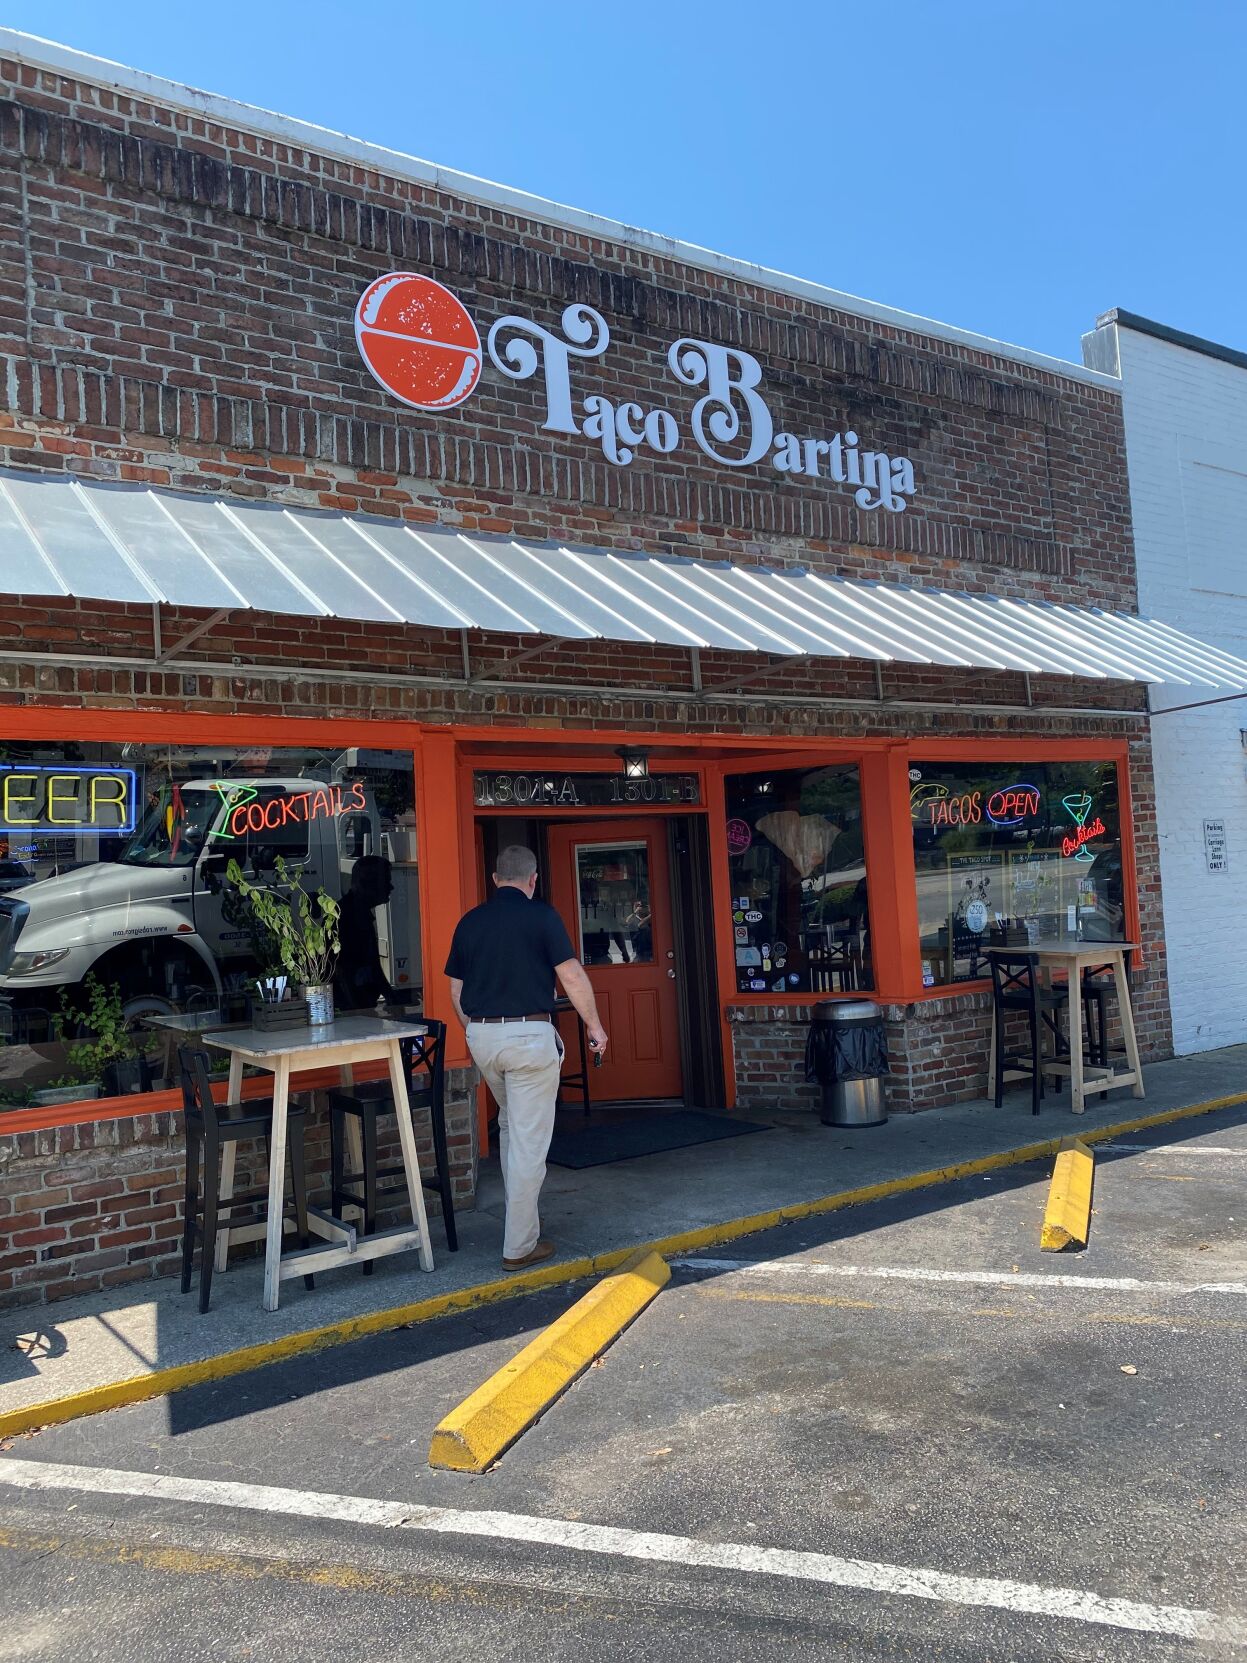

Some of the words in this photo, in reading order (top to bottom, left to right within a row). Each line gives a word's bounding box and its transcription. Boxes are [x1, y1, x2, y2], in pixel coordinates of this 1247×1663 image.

[488, 303, 679, 466] Taco
[668, 337, 917, 512] Bartina
[477, 775, 580, 802] 1301-A
[610, 776, 699, 801] 1301-B
[909, 771, 920, 779] THC
[4, 774, 127, 824] EER
[231, 783, 366, 835] COCKTAILS
[928, 791, 981, 824] TACOS
[988, 792, 1040, 816] OPEN
[1062, 817, 1106, 857] Cocktails
[1206, 822, 1223, 831] Parking
[1210, 861, 1222, 869] ONLY
